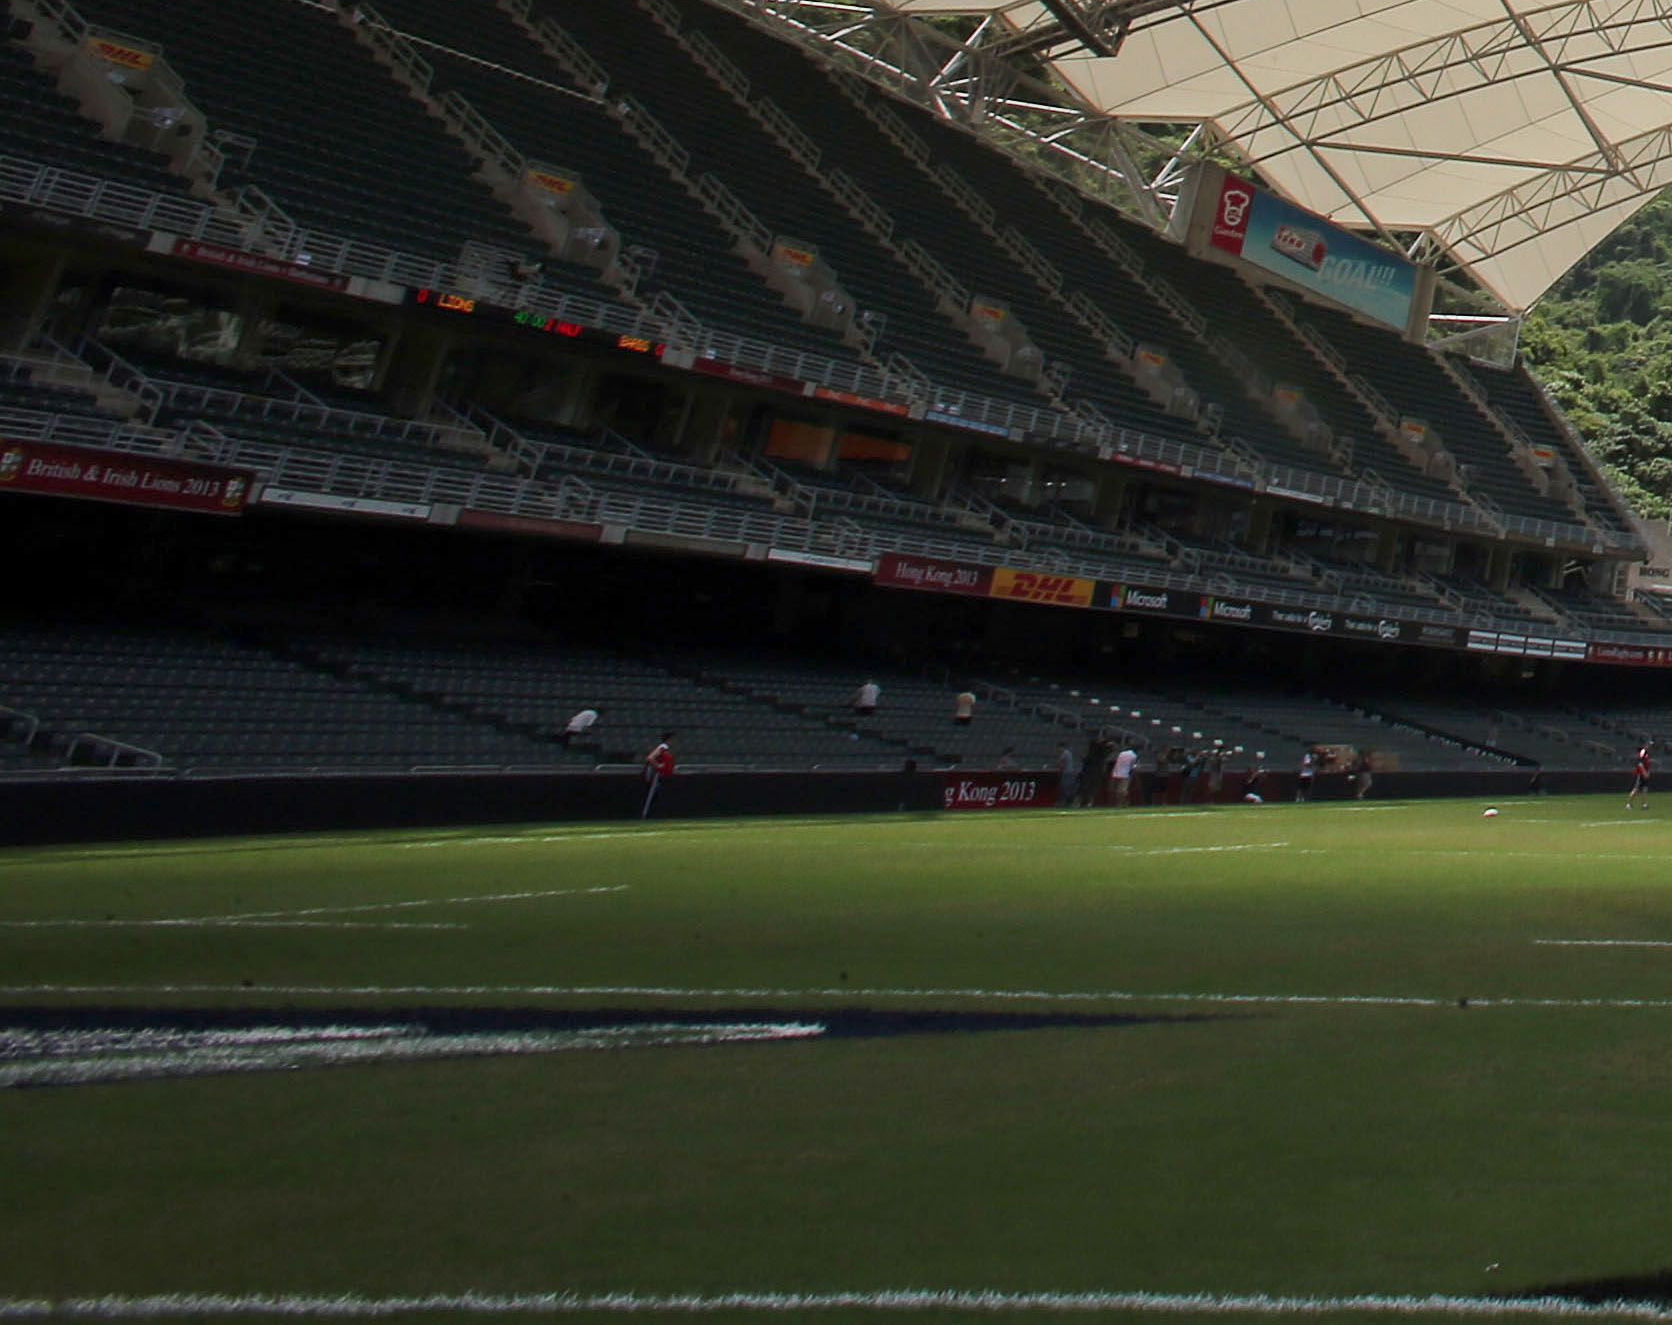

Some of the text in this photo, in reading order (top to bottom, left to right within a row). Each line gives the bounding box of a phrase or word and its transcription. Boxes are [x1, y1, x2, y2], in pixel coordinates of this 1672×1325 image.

[27, 457, 222, 497] British & Irish Lions 2013
[896, 561, 978, 587] Hong Kong 2013
[1009, 572, 1080, 604] DHL
[1126, 589, 1168, 609] Microsoft
[1213, 600, 1252, 619] Microsoft
[958, 781, 998, 806] Kong
[1000, 780, 1036, 801] 2013
